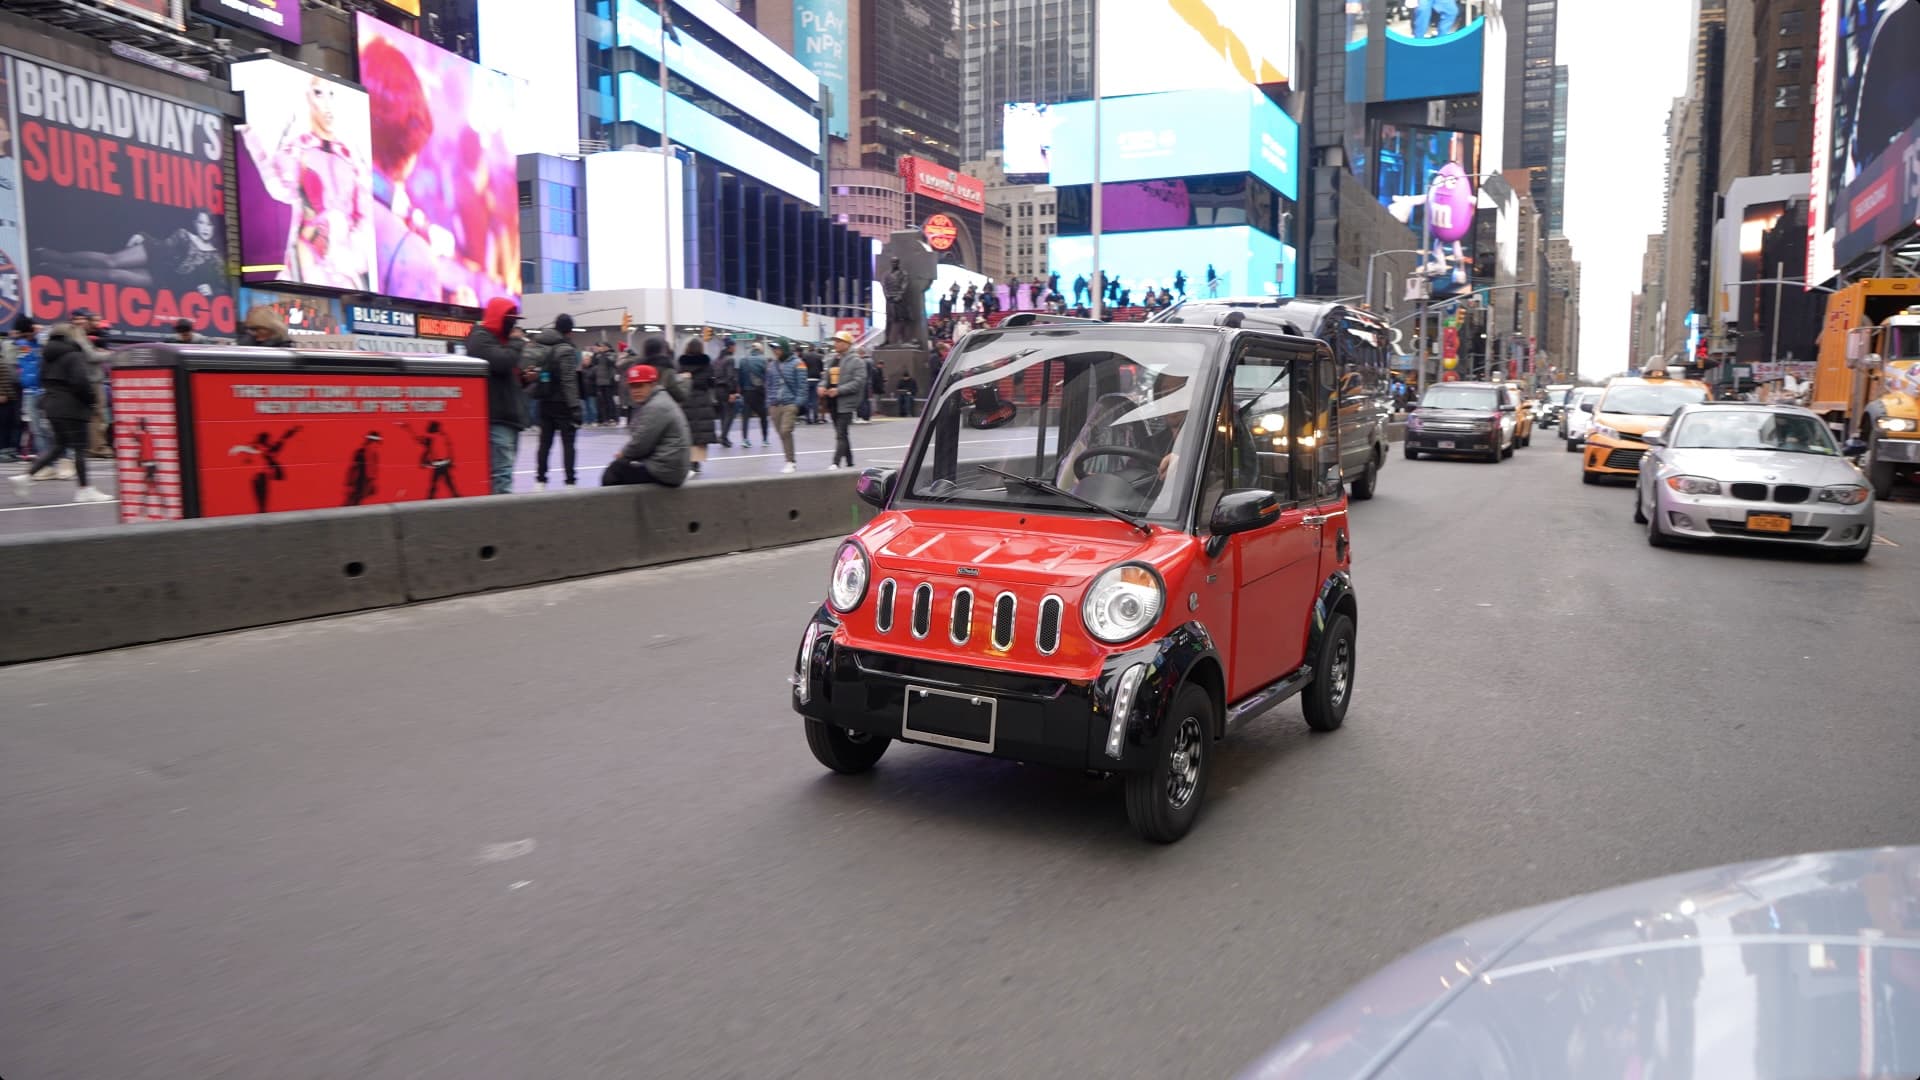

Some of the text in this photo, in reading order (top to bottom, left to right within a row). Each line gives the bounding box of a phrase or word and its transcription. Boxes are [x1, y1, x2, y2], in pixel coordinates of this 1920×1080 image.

[16, 58, 222, 161] BROADWAY'S
[21, 120, 225, 215] SURE THING
[30, 274, 236, 334] CHICAGO
[353, 306, 415, 326] BLUE FIN
